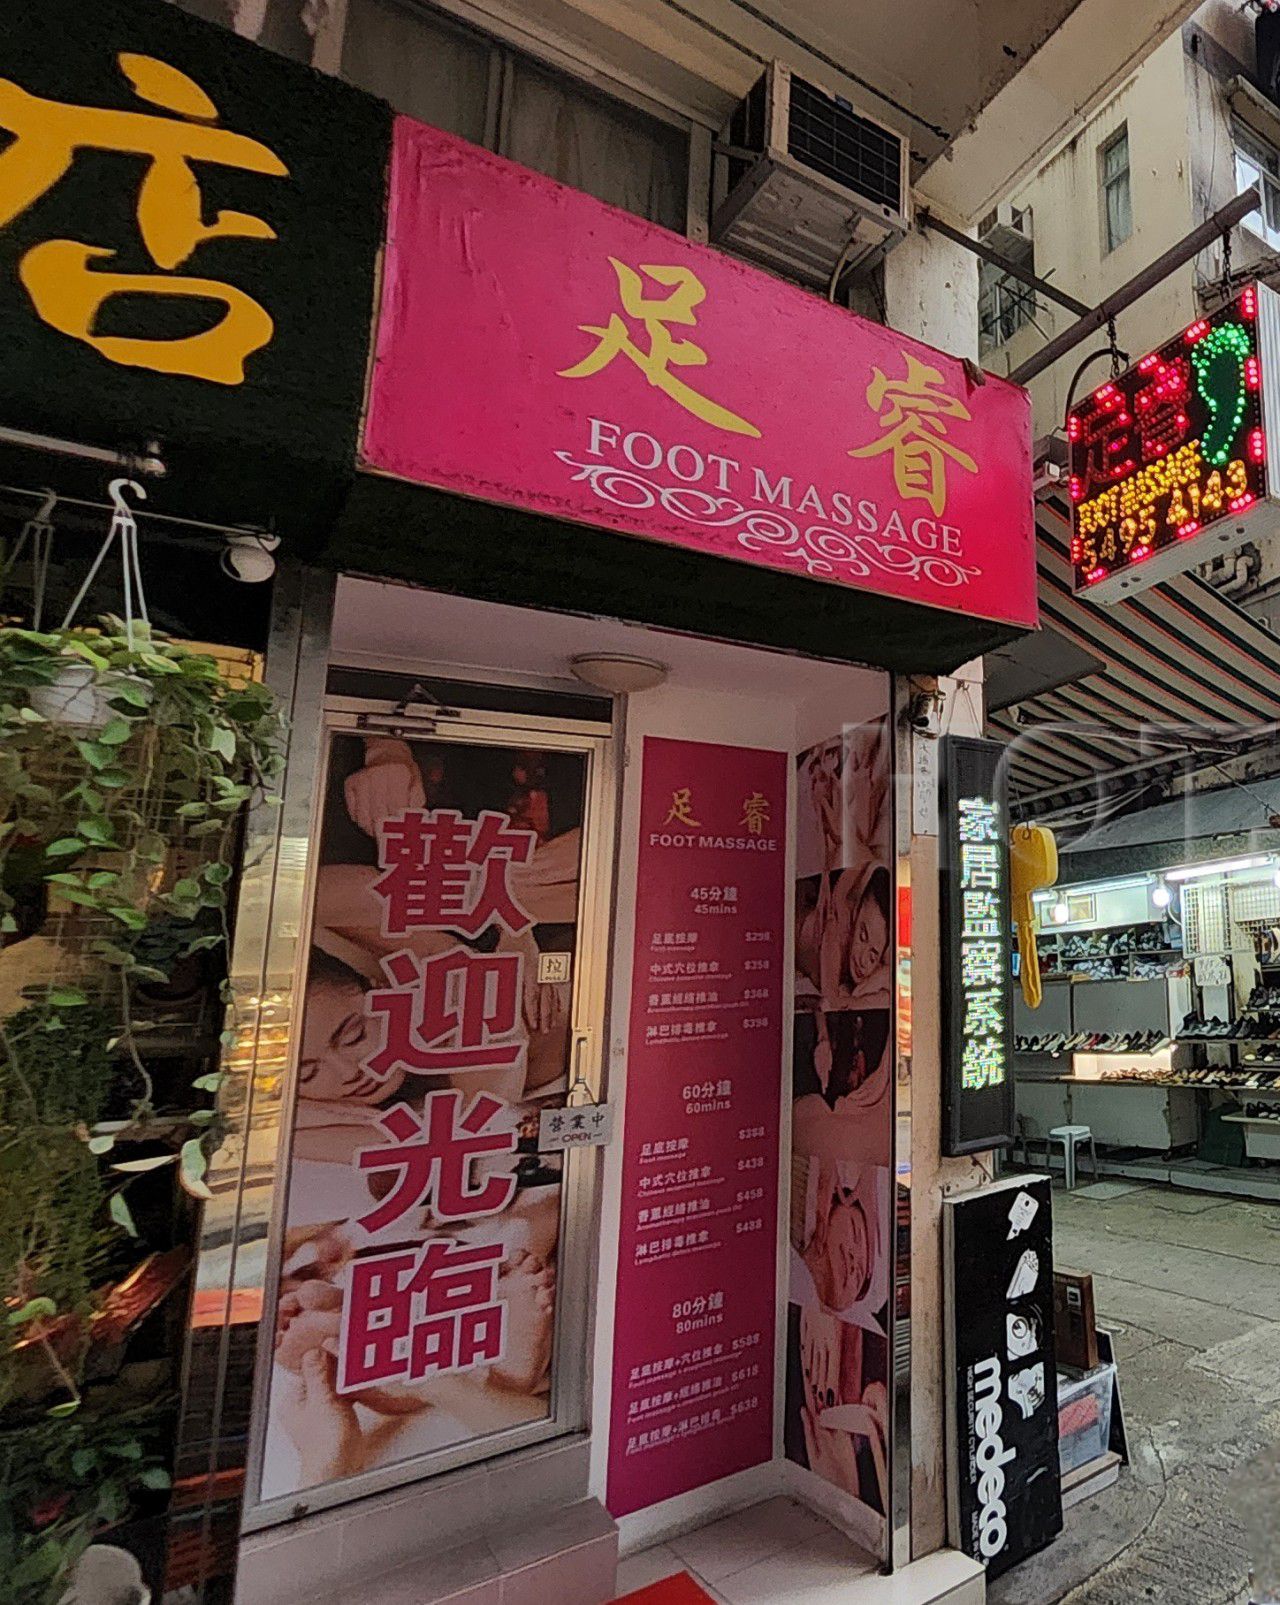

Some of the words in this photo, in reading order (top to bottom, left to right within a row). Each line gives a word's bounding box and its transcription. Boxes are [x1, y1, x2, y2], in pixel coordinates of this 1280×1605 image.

[0, 52, 290, 385] 店
[586, 417, 740, 493] FOOT
[751, 466, 963, 557] MASSAGE
[650, 834, 694, 848] FOOT
[699, 836, 777, 851] MASSAGE
[336, 809, 538, 1395] 歡迎光臨
[685, 1099, 731, 1114] 60mins
[676, 1313, 724, 1334] 80mins
[975, 1356, 1017, 1558] medeco
